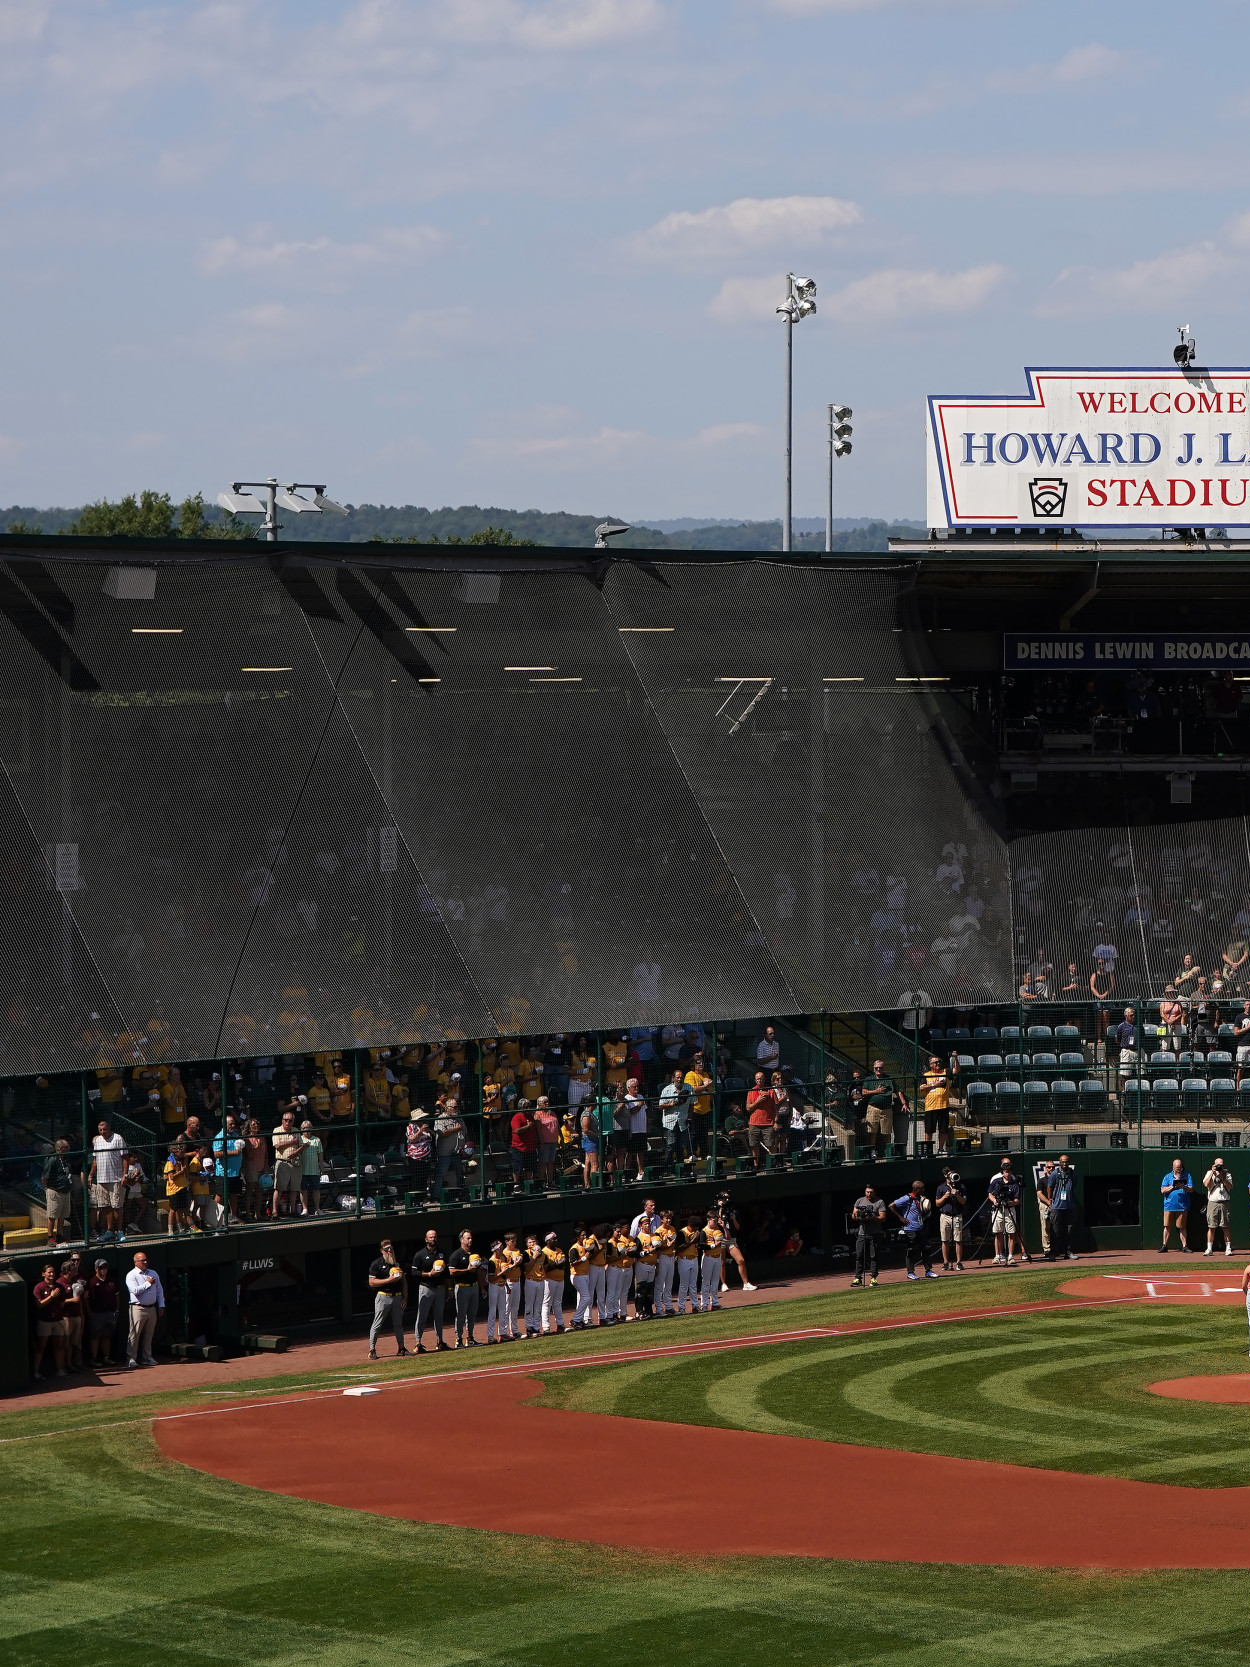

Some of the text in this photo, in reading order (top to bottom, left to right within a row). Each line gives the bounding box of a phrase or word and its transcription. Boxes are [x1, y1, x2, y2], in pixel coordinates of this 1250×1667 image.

[1077, 391, 1247, 414] WELCOME
[961, 432, 1162, 465] HOWARD
[1176, 432, 1204, 465] J.
[1017, 642, 1085, 659] DENNIS
[1095, 642, 1154, 659] LEWIN
[242, 1258, 274, 1270] #LLWS
